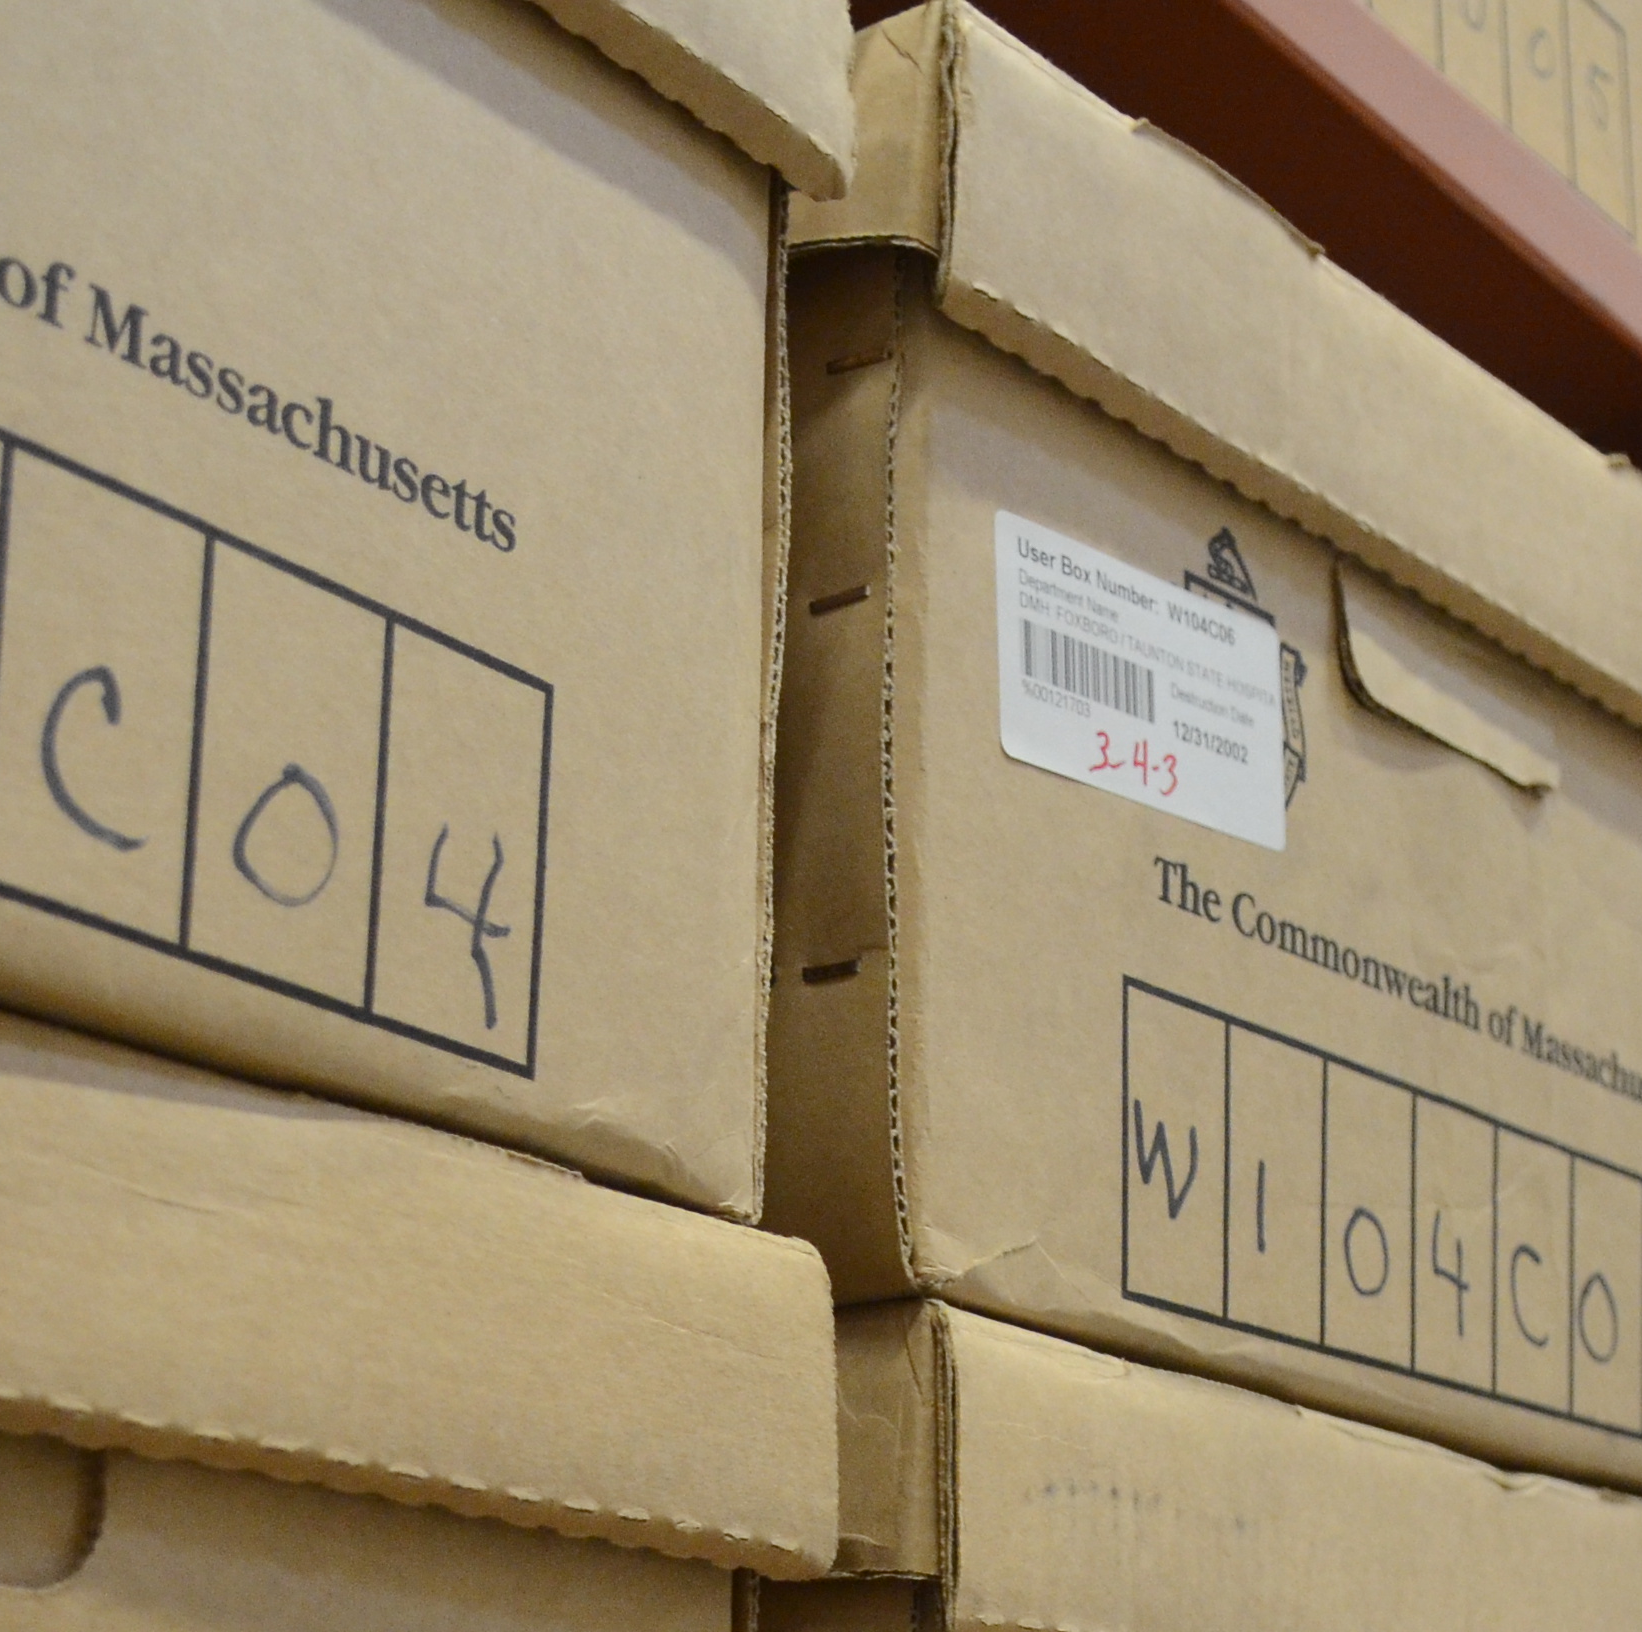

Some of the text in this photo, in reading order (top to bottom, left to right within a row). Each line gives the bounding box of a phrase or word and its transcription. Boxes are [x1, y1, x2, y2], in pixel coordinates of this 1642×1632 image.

[84, 287, 519, 556] Massachusetts
[1017, 536, 1236, 647] User Box Number: W104C06
[1057, 605, 1119, 645] FOXBORO
[1172, 719, 1249, 764] 12/31/2002
[1153, 856, 1221, 923] The
[1233, 892, 1480, 1031] Commonwealth
[1489, 1005, 1515, 1047] of
